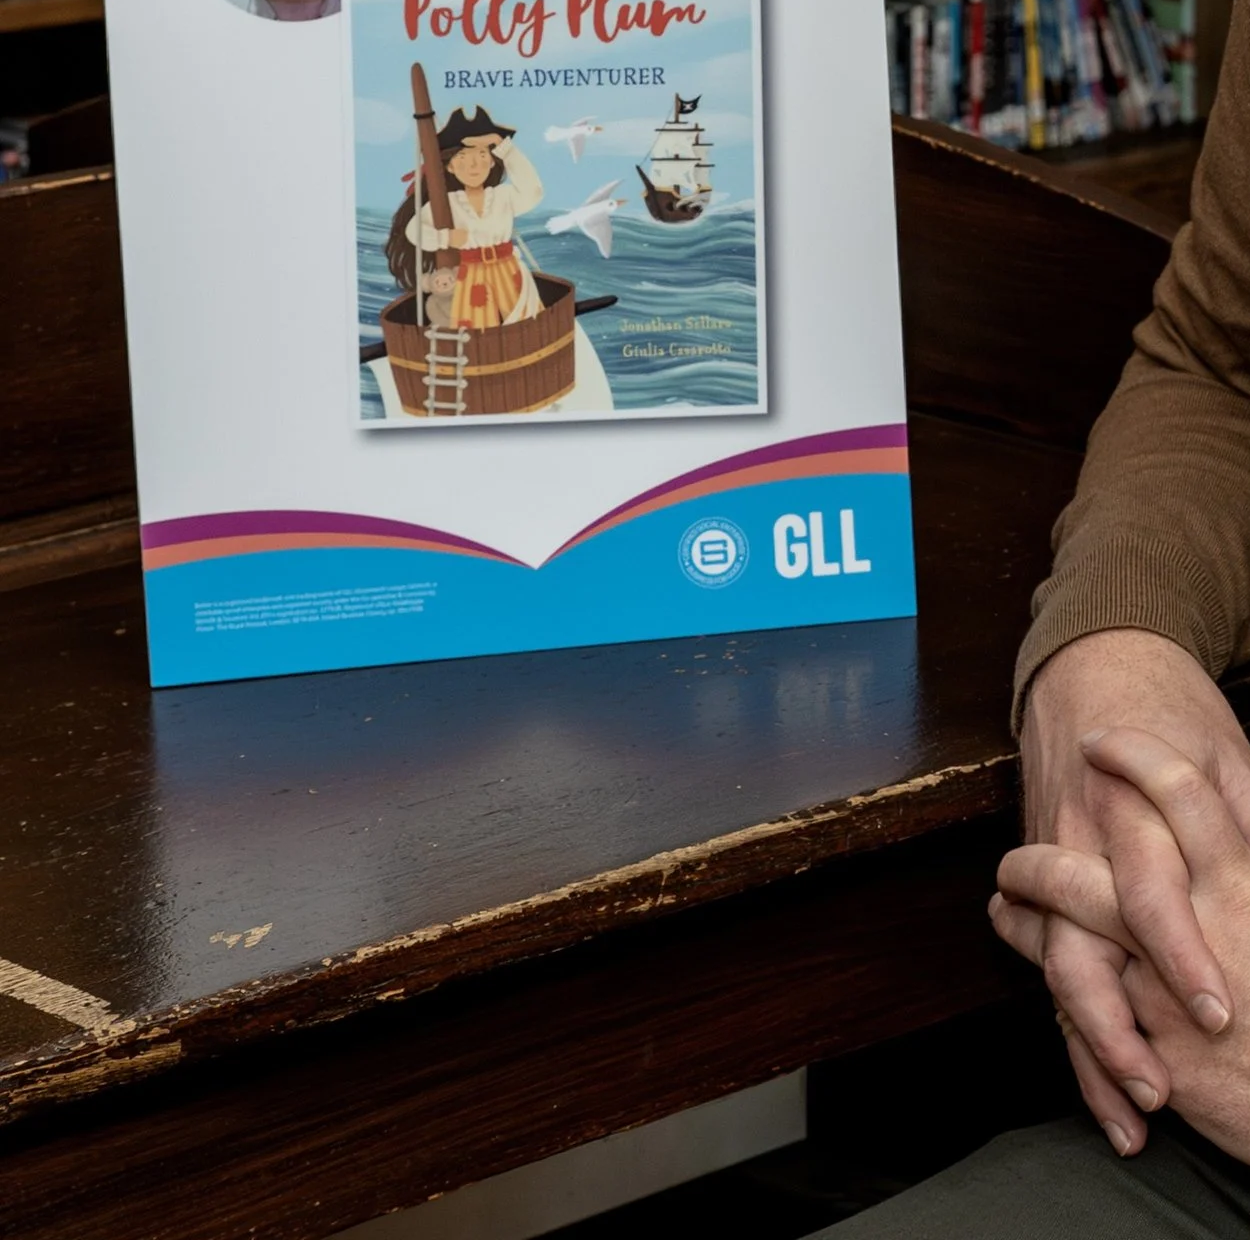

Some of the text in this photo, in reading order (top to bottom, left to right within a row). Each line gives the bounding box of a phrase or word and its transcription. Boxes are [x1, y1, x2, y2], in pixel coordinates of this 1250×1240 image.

[443, 67, 666, 89] BRAVE ADVENTURER
[773, 508, 872, 579] GLL
